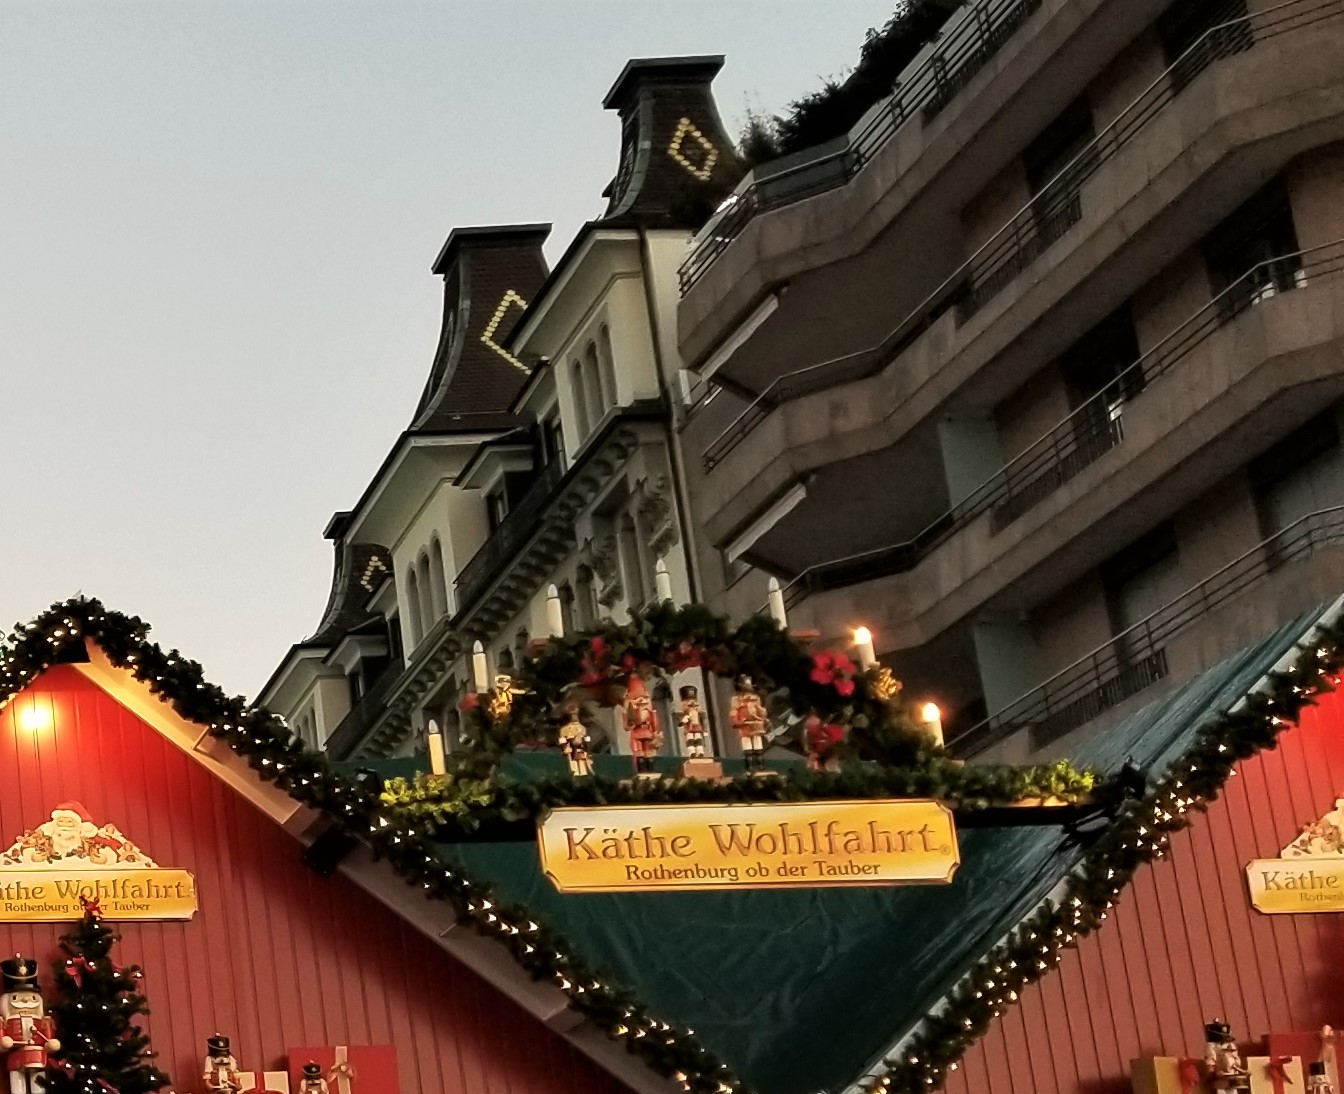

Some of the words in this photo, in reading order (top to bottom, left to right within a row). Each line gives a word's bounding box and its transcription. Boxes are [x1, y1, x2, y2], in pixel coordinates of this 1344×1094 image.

[563, 826, 696, 860] Käthe
[709, 820, 939, 857] Wohlfahrt
[625, 863, 739, 882] Rothenburg
[746, 863, 770, 878] ob
[777, 862, 808, 877] der
[814, 859, 881, 876] Tauber
[1261, 870, 1340, 891] Käthe
[54, 878, 188, 900] Wohlfahrt
[5, 902, 69, 913] Rothenburg
[114, 901, 151, 911] Tauber
